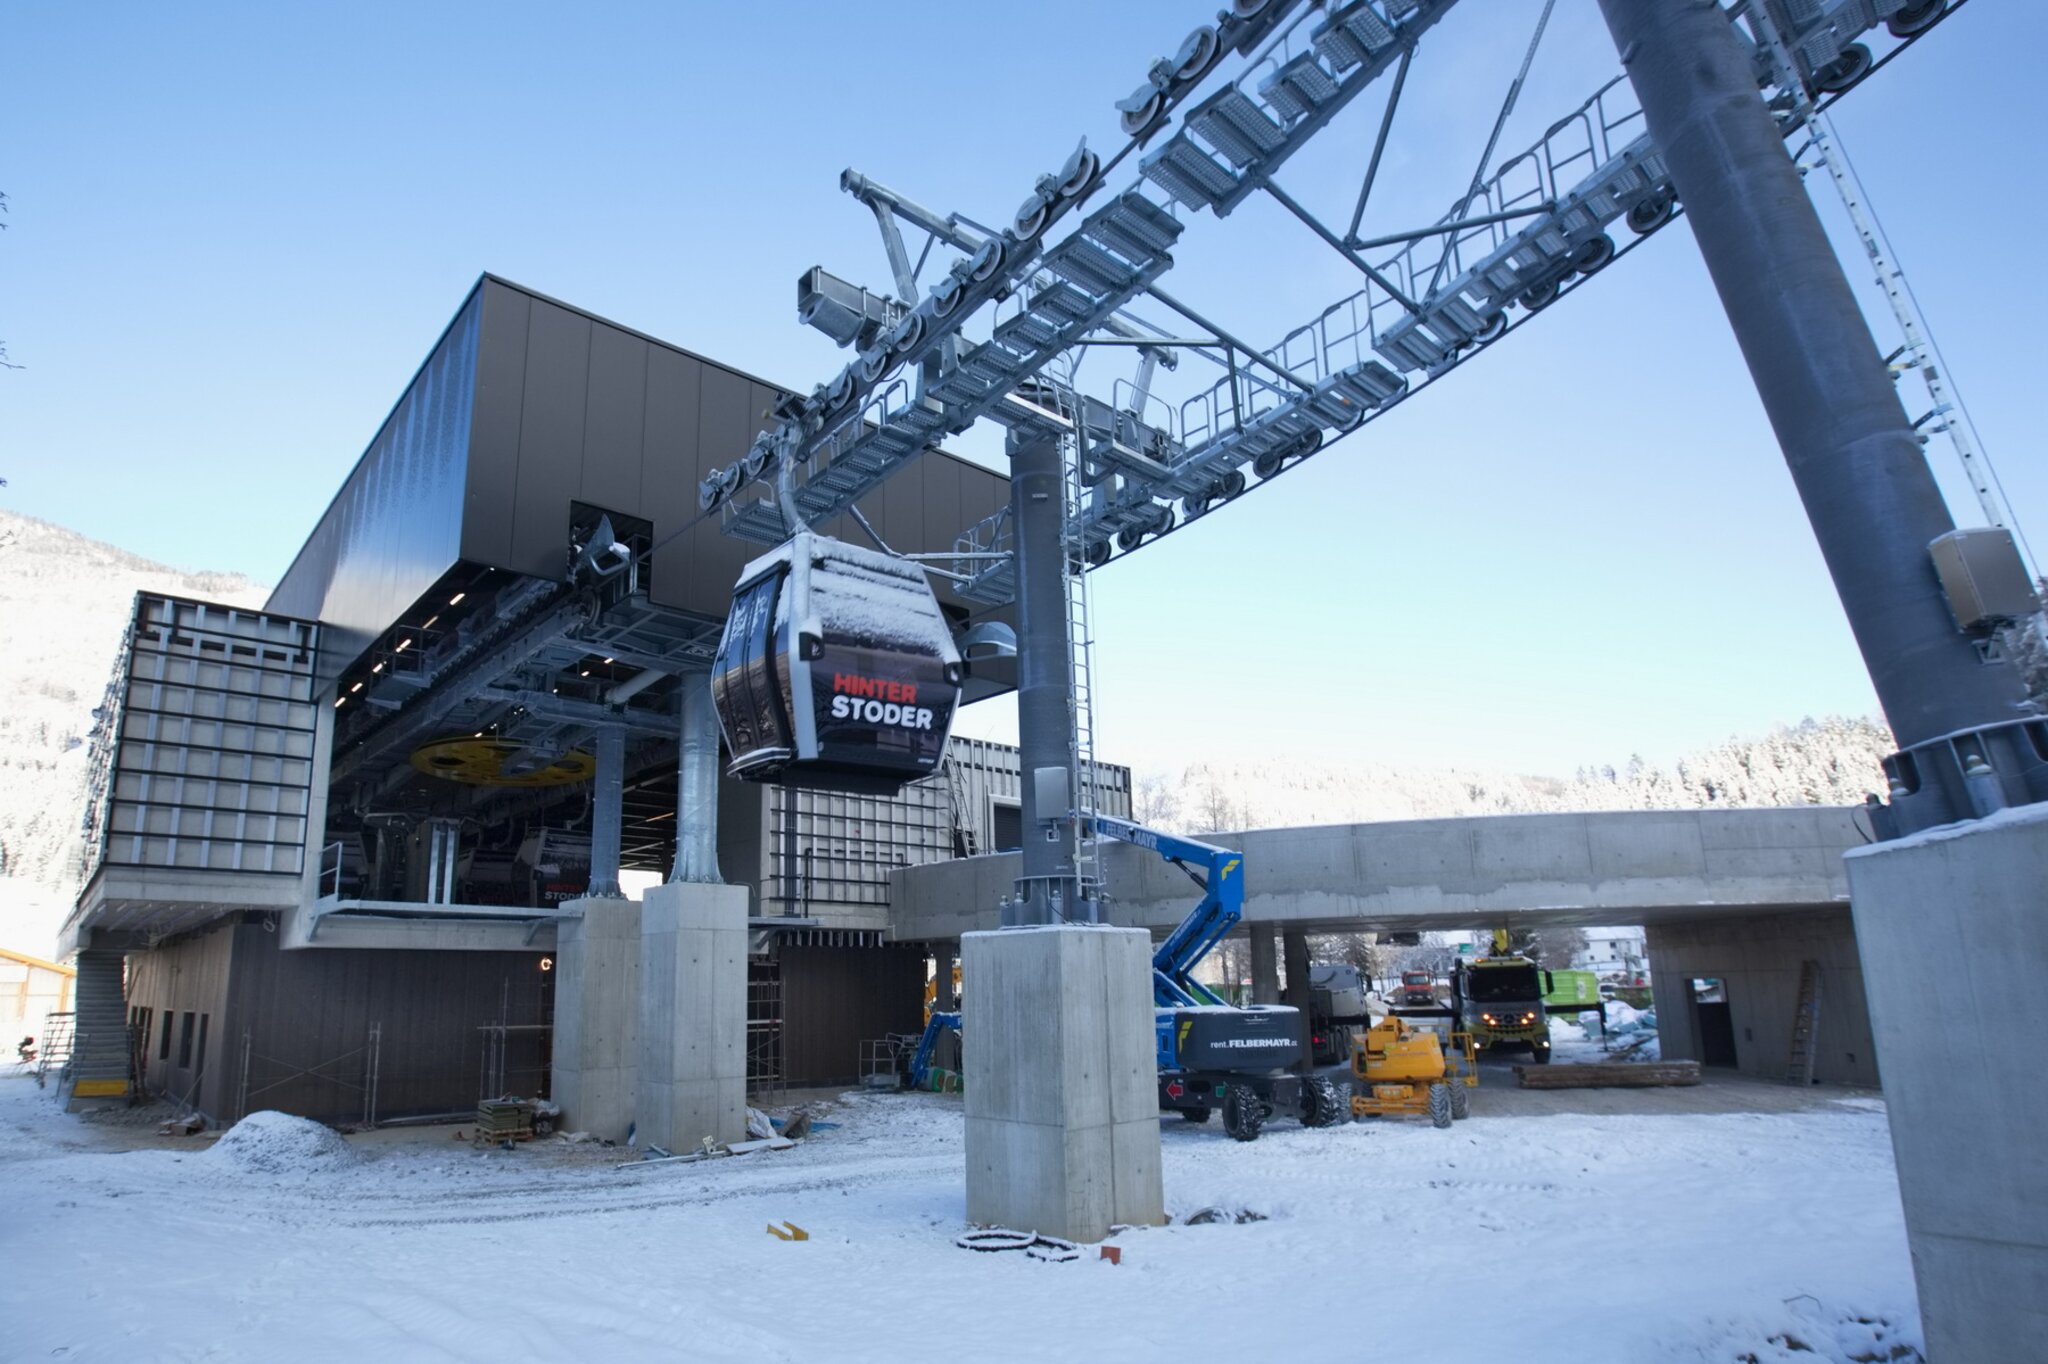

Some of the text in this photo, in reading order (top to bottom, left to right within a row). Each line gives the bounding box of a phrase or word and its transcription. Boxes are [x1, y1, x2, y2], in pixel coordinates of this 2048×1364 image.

[834, 672, 917, 704] HINTER
[831, 695, 933, 730] STODER
[545, 891, 582, 900] STODE
